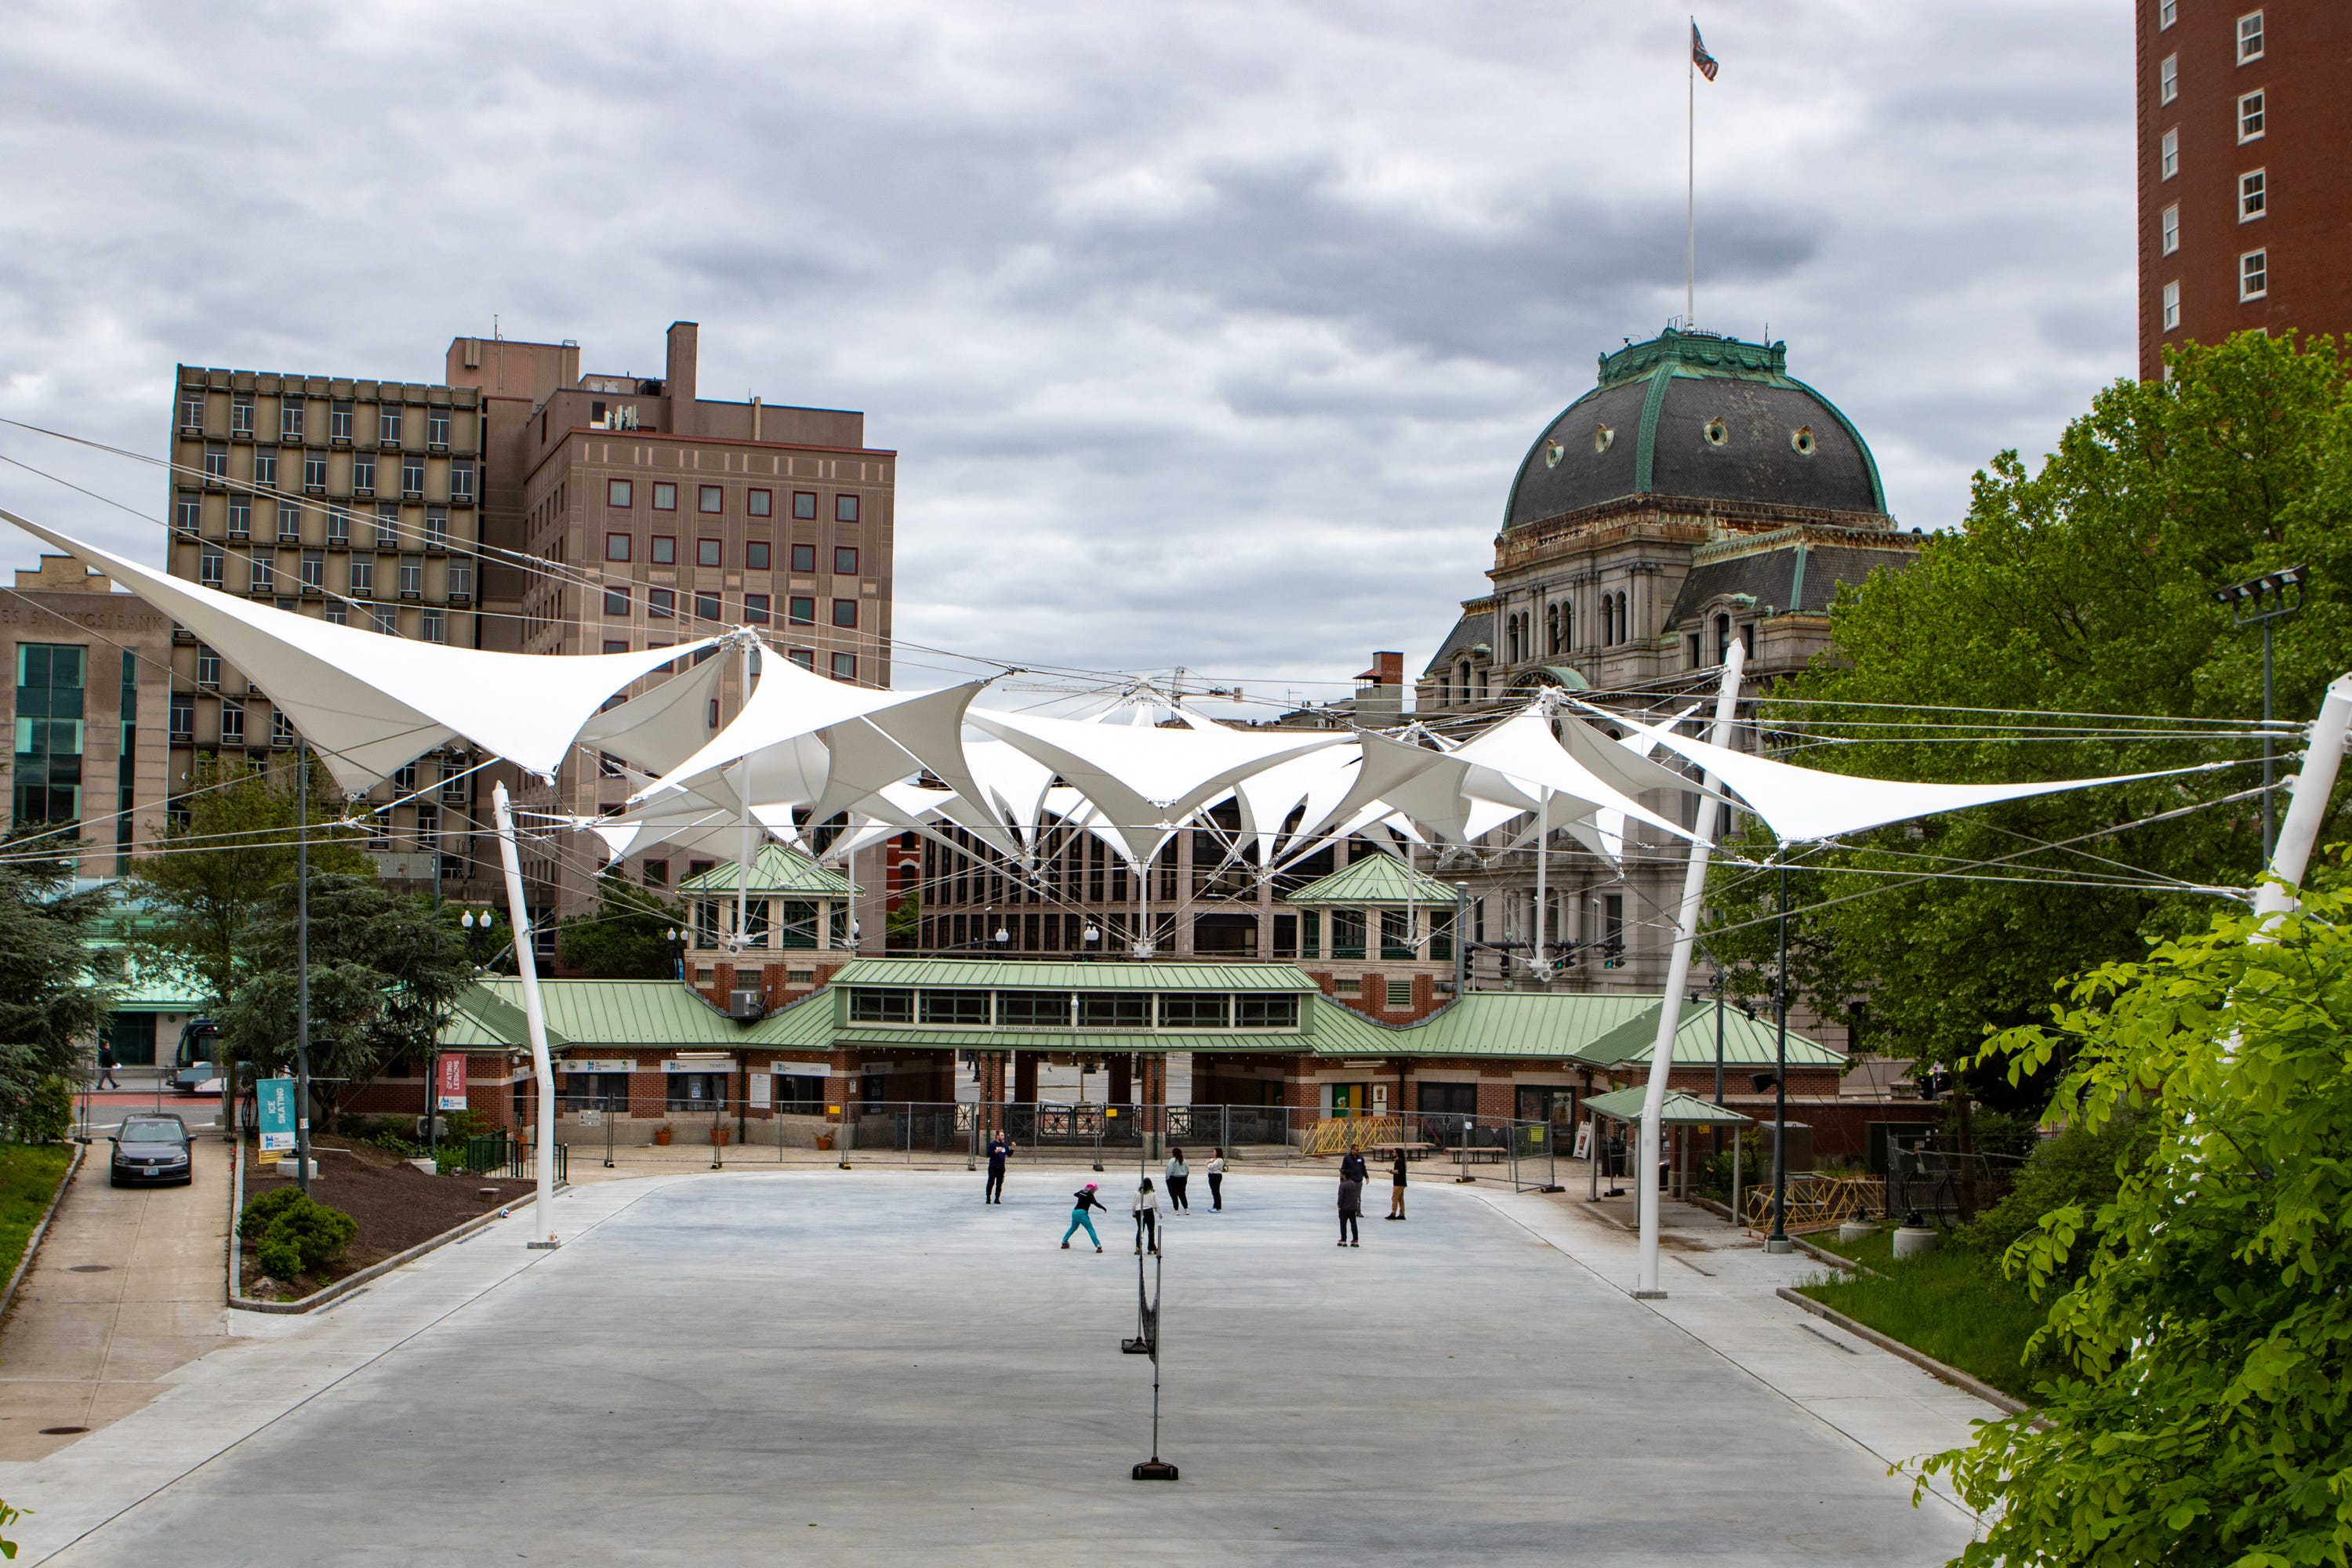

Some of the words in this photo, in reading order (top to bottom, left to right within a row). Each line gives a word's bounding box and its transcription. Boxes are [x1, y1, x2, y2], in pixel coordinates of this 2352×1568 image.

[117, 615, 163, 630] BANK
[267, 1101, 276, 1113] ICE
[276, 1087, 285, 1123] SKATING
